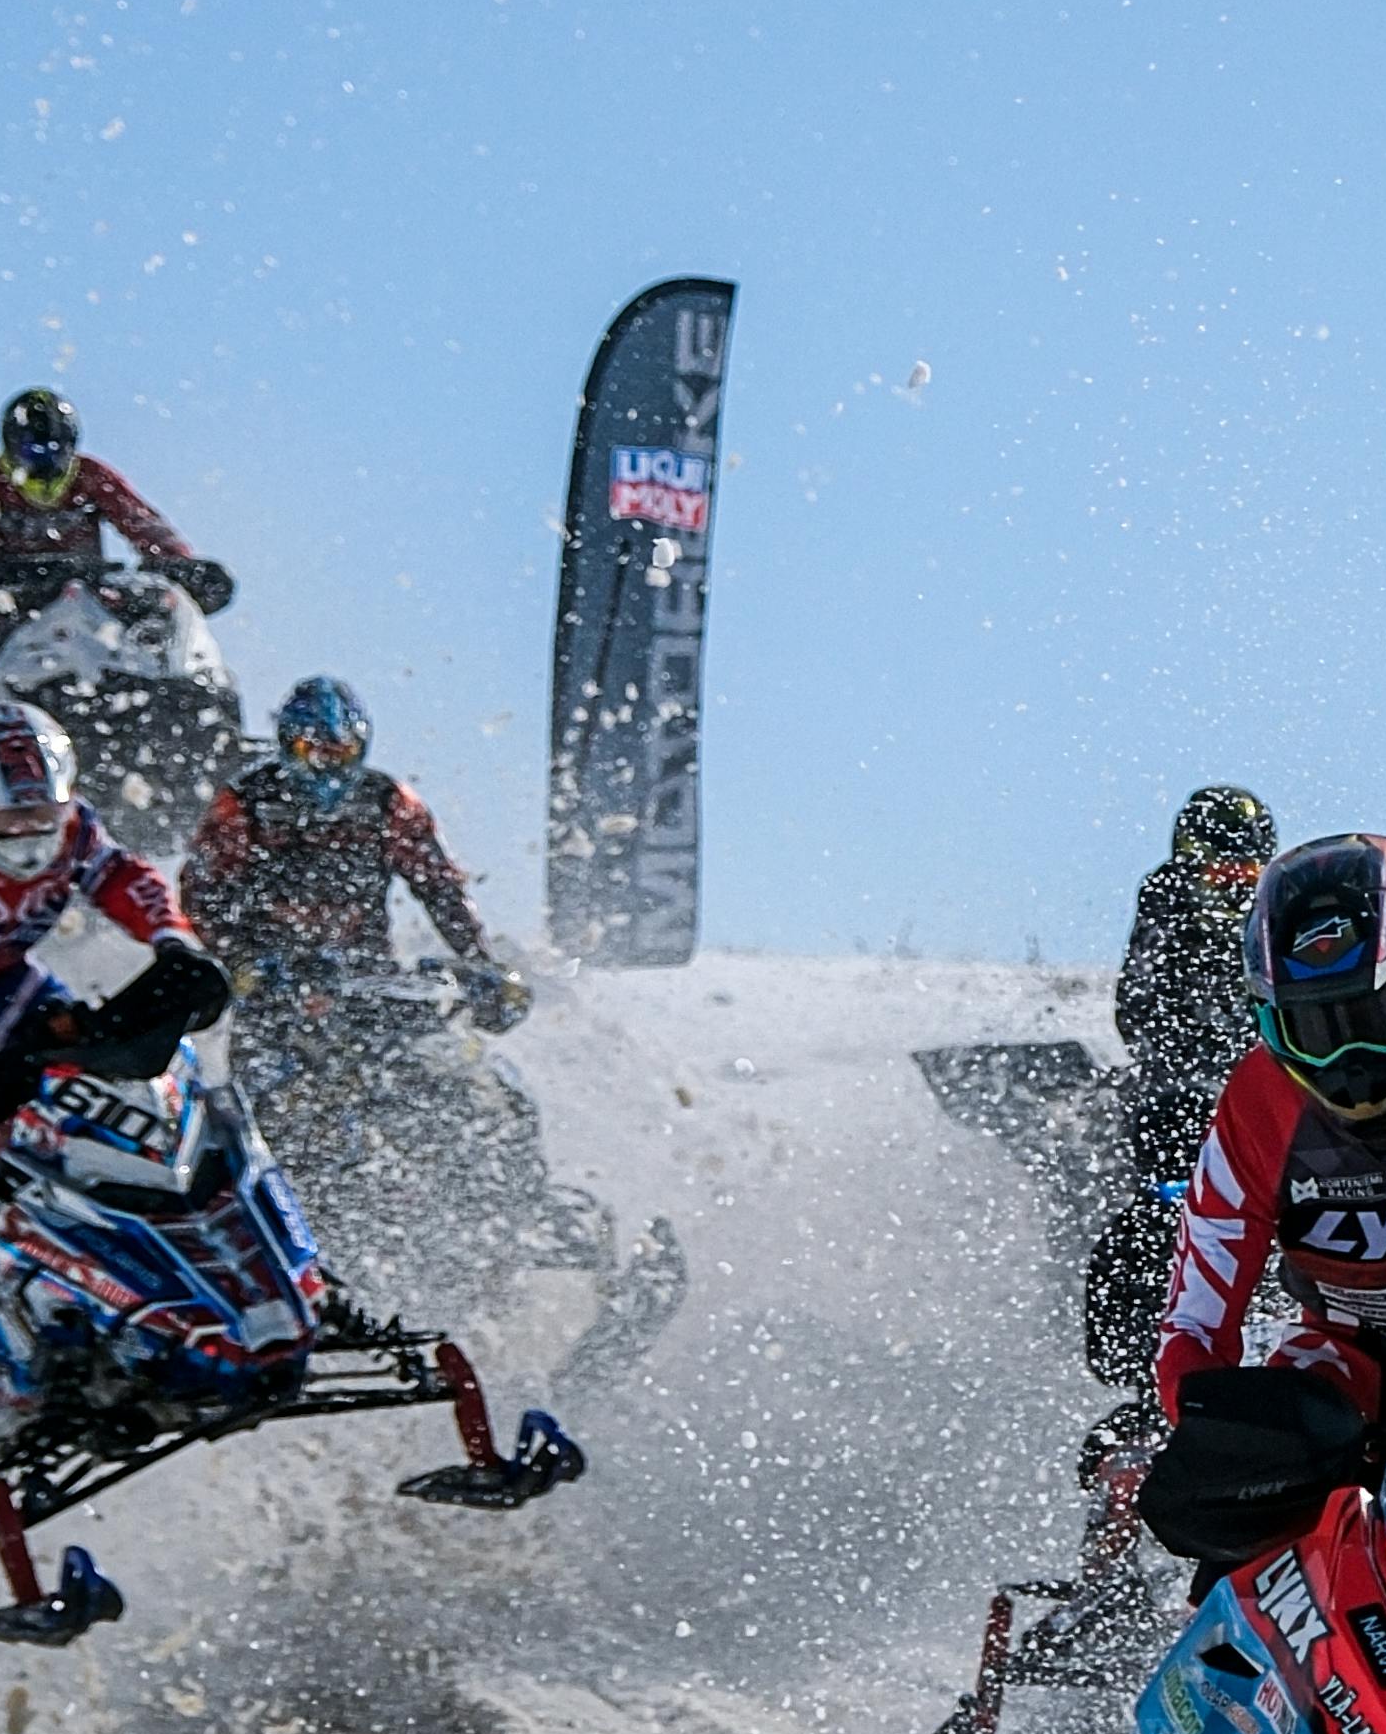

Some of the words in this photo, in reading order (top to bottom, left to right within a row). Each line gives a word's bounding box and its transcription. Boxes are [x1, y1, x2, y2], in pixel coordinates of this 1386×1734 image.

[618, 484, 704, 528] MOLY
[634, 309, 725, 957] MOTORKE
[53, 1076, 158, 1142] 610
[1328, 1186, 1375, 1198] RACING
[1237, 1480, 1288, 1501] LYNX
[1255, 1548, 1331, 1664] LYNX
